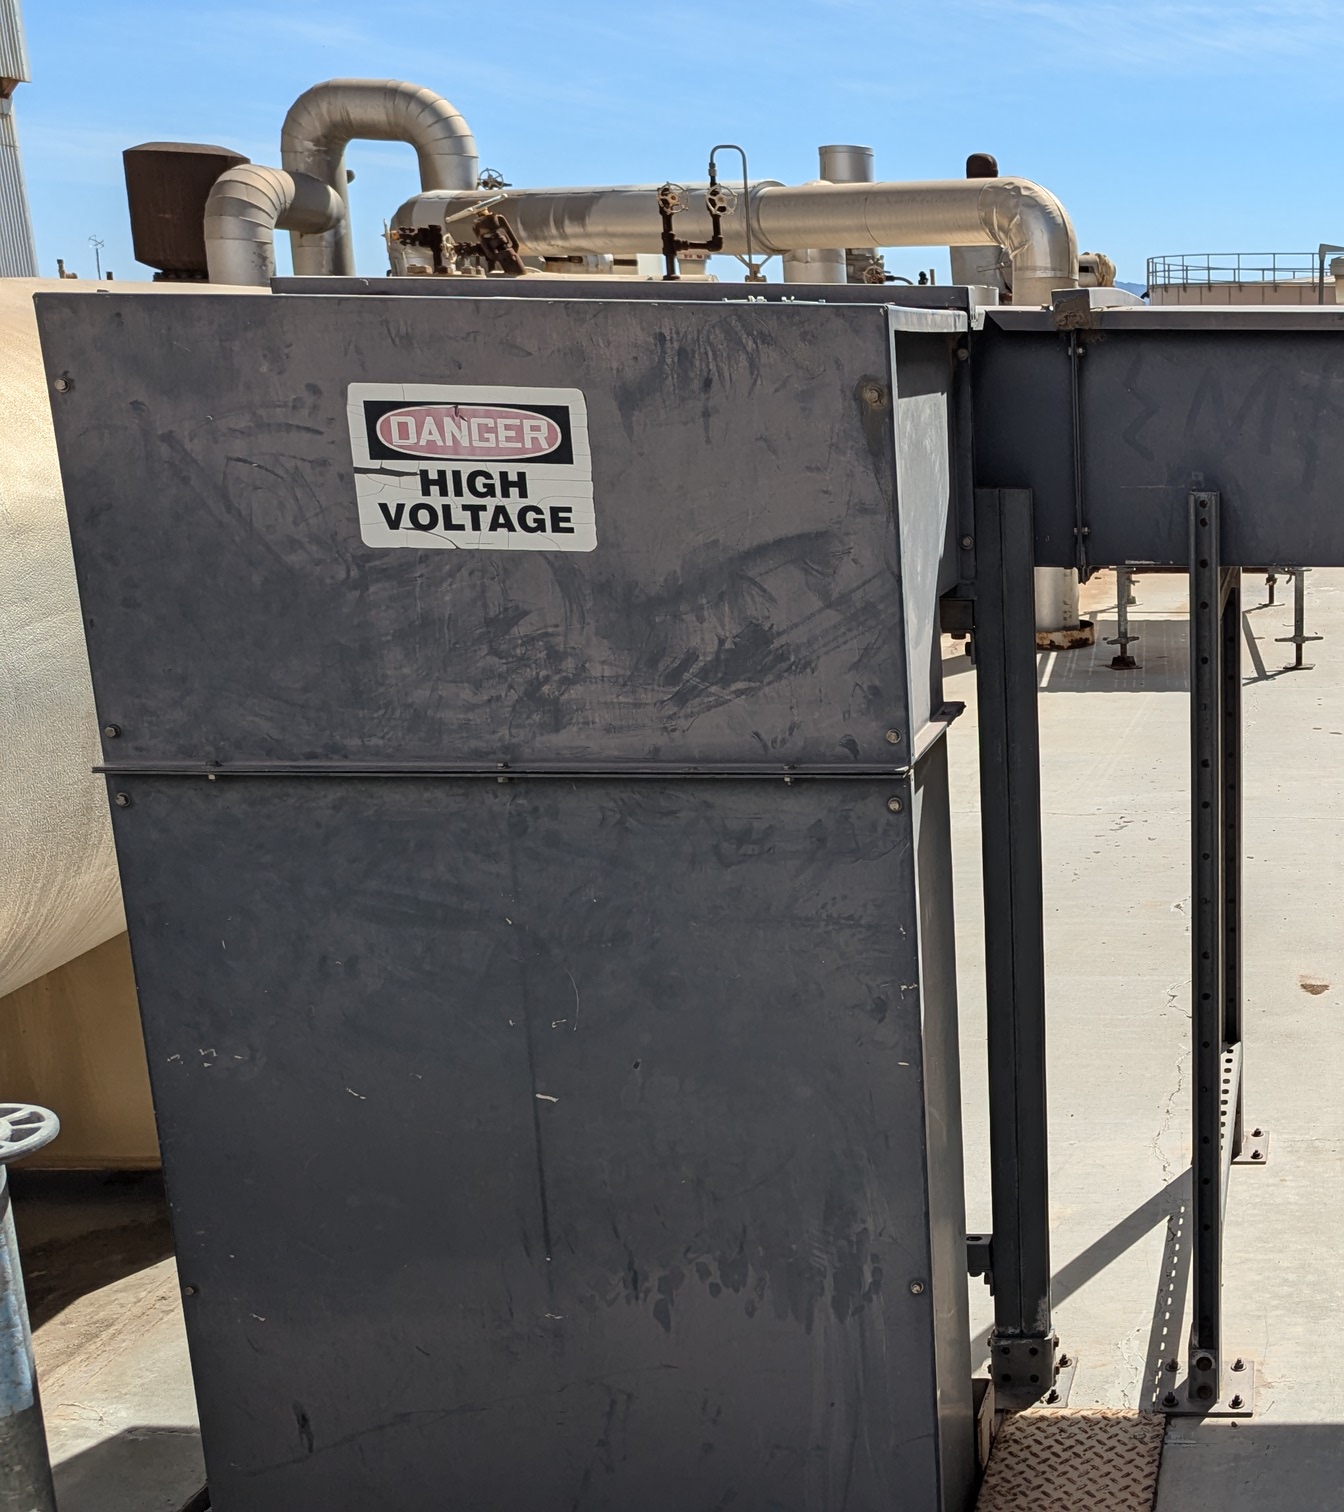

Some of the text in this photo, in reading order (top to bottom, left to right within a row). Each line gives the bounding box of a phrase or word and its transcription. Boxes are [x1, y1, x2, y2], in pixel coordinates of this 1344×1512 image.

[389, 415, 550, 450] DANGER
[419, 468, 529, 499] HIGH
[377, 502, 576, 534] VOLTAGE
